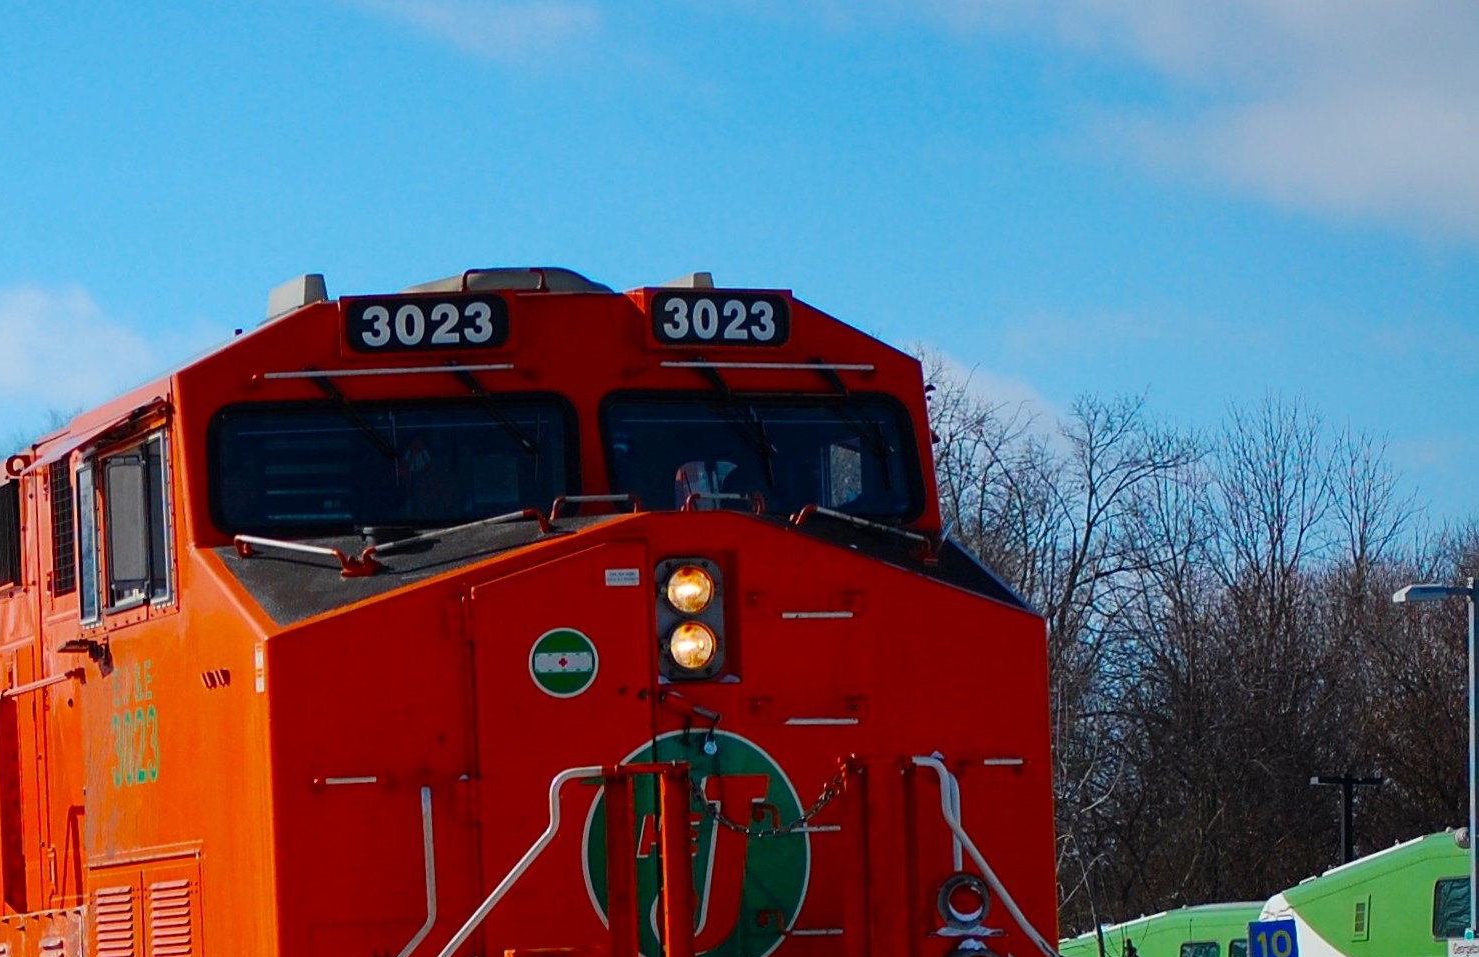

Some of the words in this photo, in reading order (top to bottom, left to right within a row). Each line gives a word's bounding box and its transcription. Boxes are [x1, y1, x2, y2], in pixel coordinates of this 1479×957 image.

[361, 301, 494, 347] 3023
[662, 297, 776, 341] 3023
[111, 705, 160, 789] 3023
